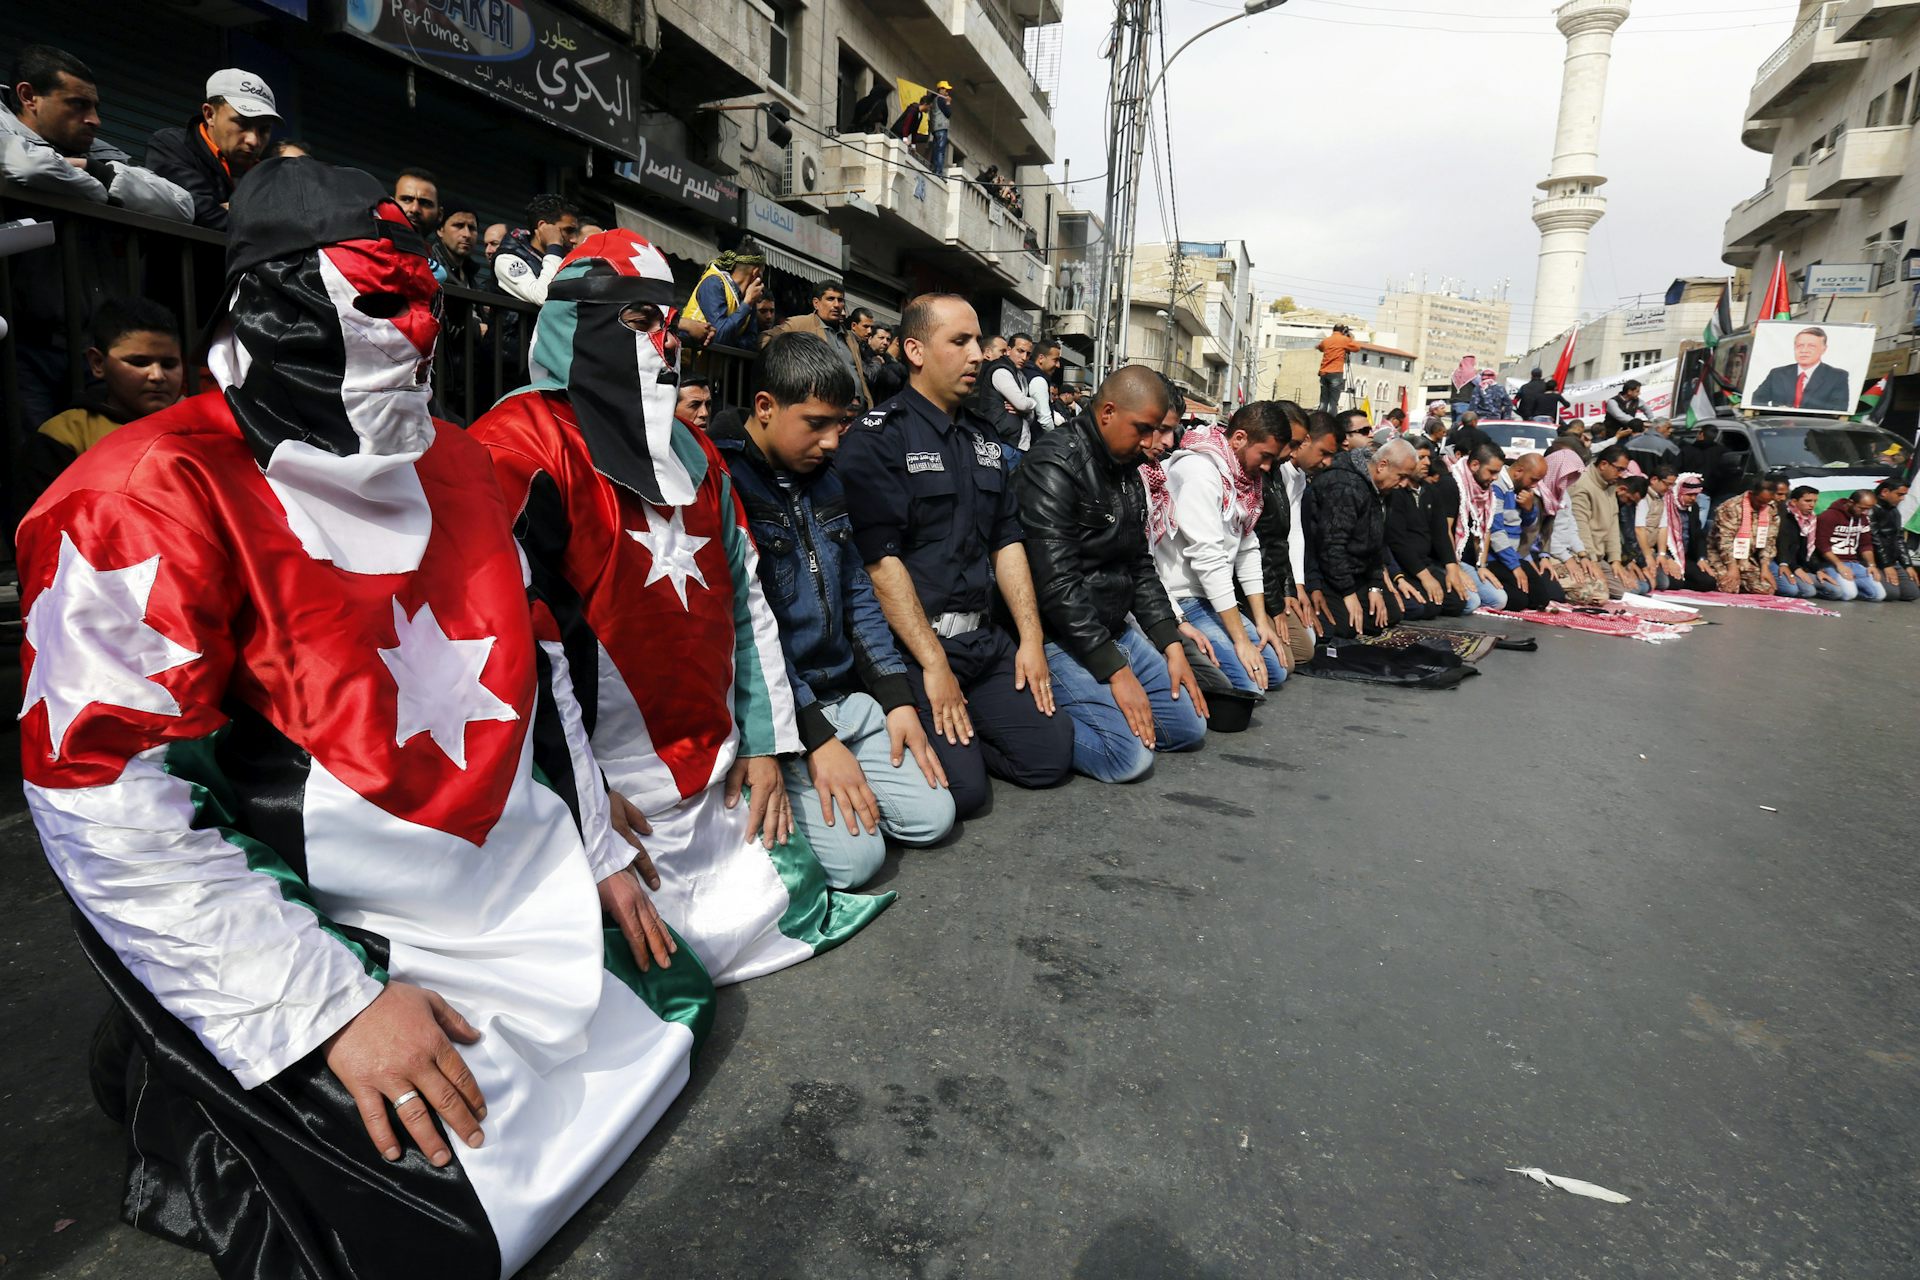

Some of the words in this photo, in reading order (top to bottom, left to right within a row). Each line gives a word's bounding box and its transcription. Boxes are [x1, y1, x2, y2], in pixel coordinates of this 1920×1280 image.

[391, 0, 470, 52] Perfumes
[427, 0, 513, 48] AKRI
[539, 21, 578, 51] عطور
[239, 81, 275, 105] Sedo
[536, 52, 631, 126] البكري
[645, 157, 682, 185] ناصر
[682, 177, 720, 202] سليم
[754, 204, 794, 233] للحقائب
